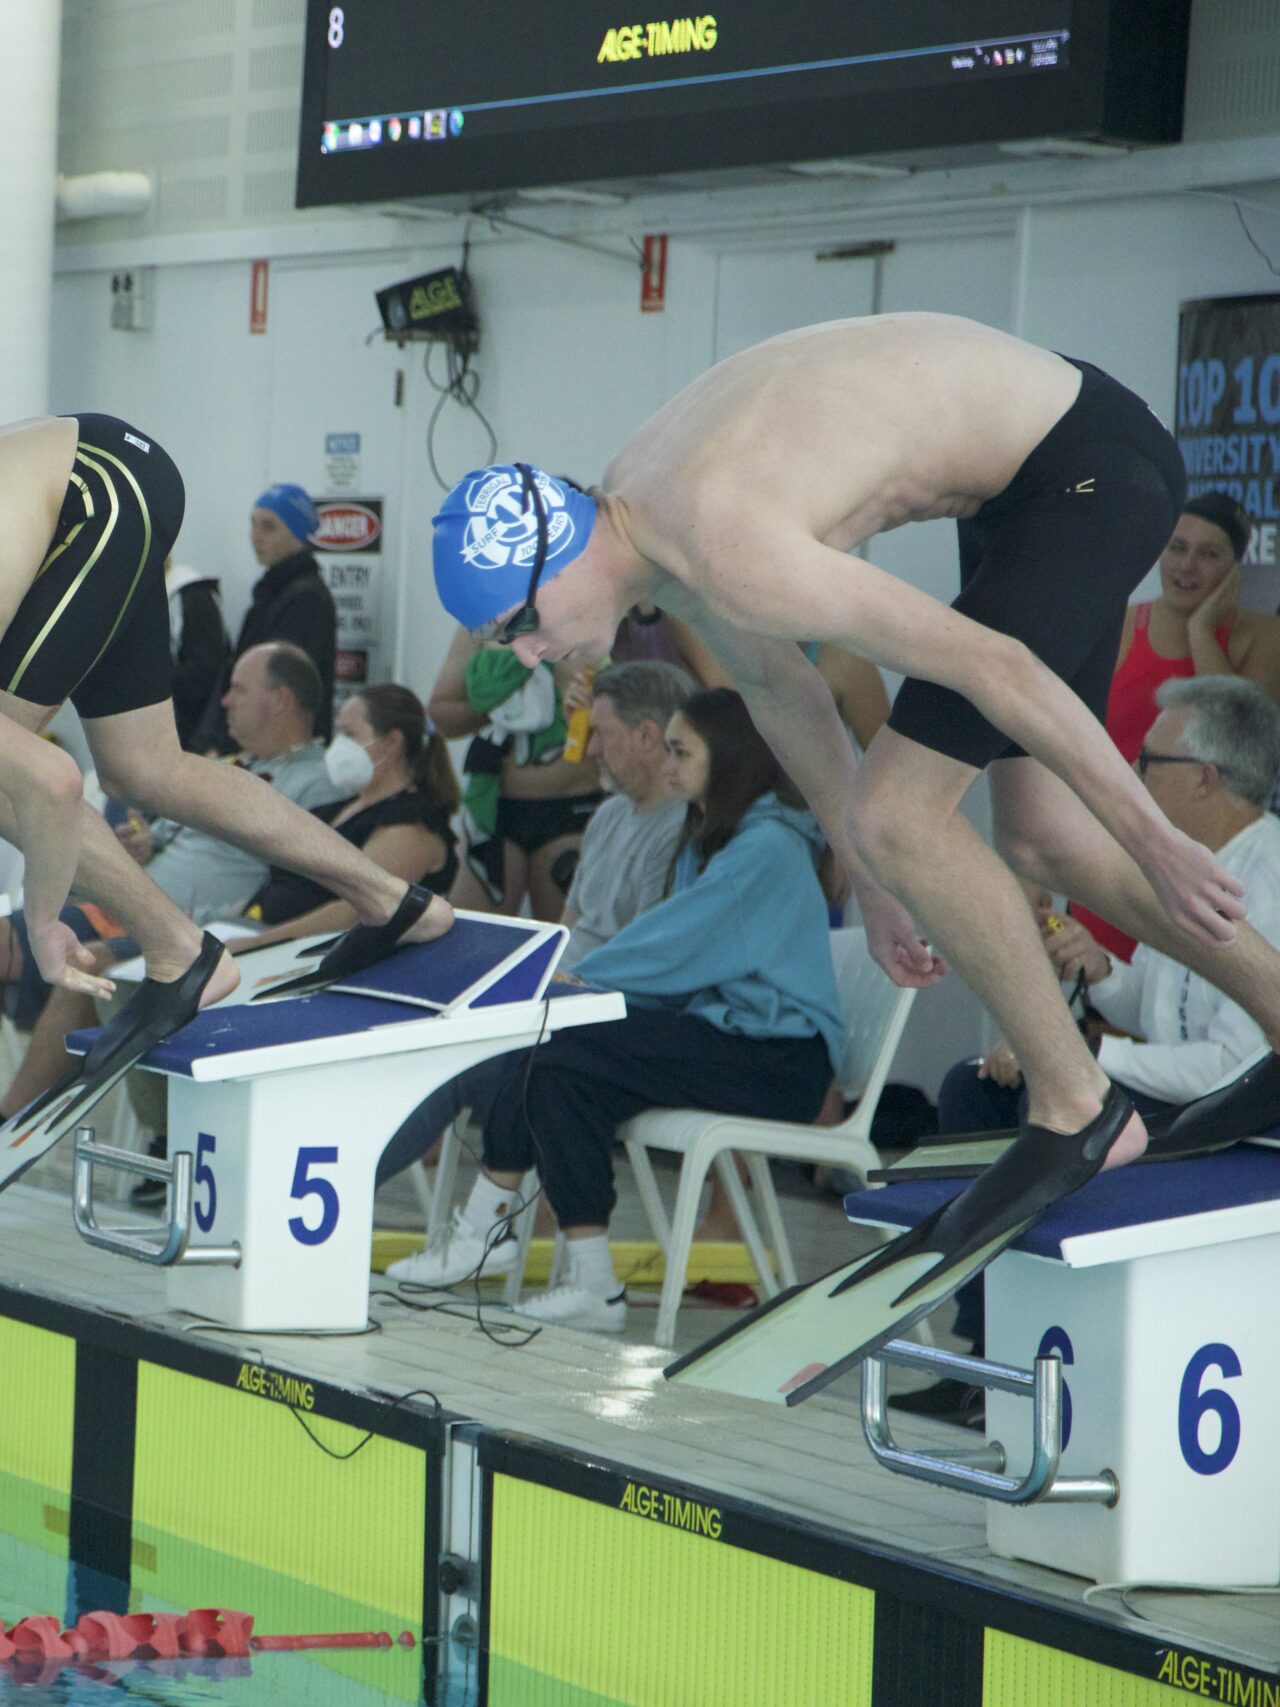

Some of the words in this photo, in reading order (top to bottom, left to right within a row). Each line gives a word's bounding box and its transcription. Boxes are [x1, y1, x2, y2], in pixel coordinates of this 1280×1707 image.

[328, 7, 344, 48] 8
[475, 478, 507, 509] TERRIGAL
[472, 528, 498, 554] SURF
[194, 1132, 217, 1233] 5
[288, 1146, 340, 1246] 5
[236, 1362, 315, 1410] ALGE-TIMING
[1178, 1342, 1242, 1476] 6
[619, 1482, 722, 1539] ALGE-TIMING
